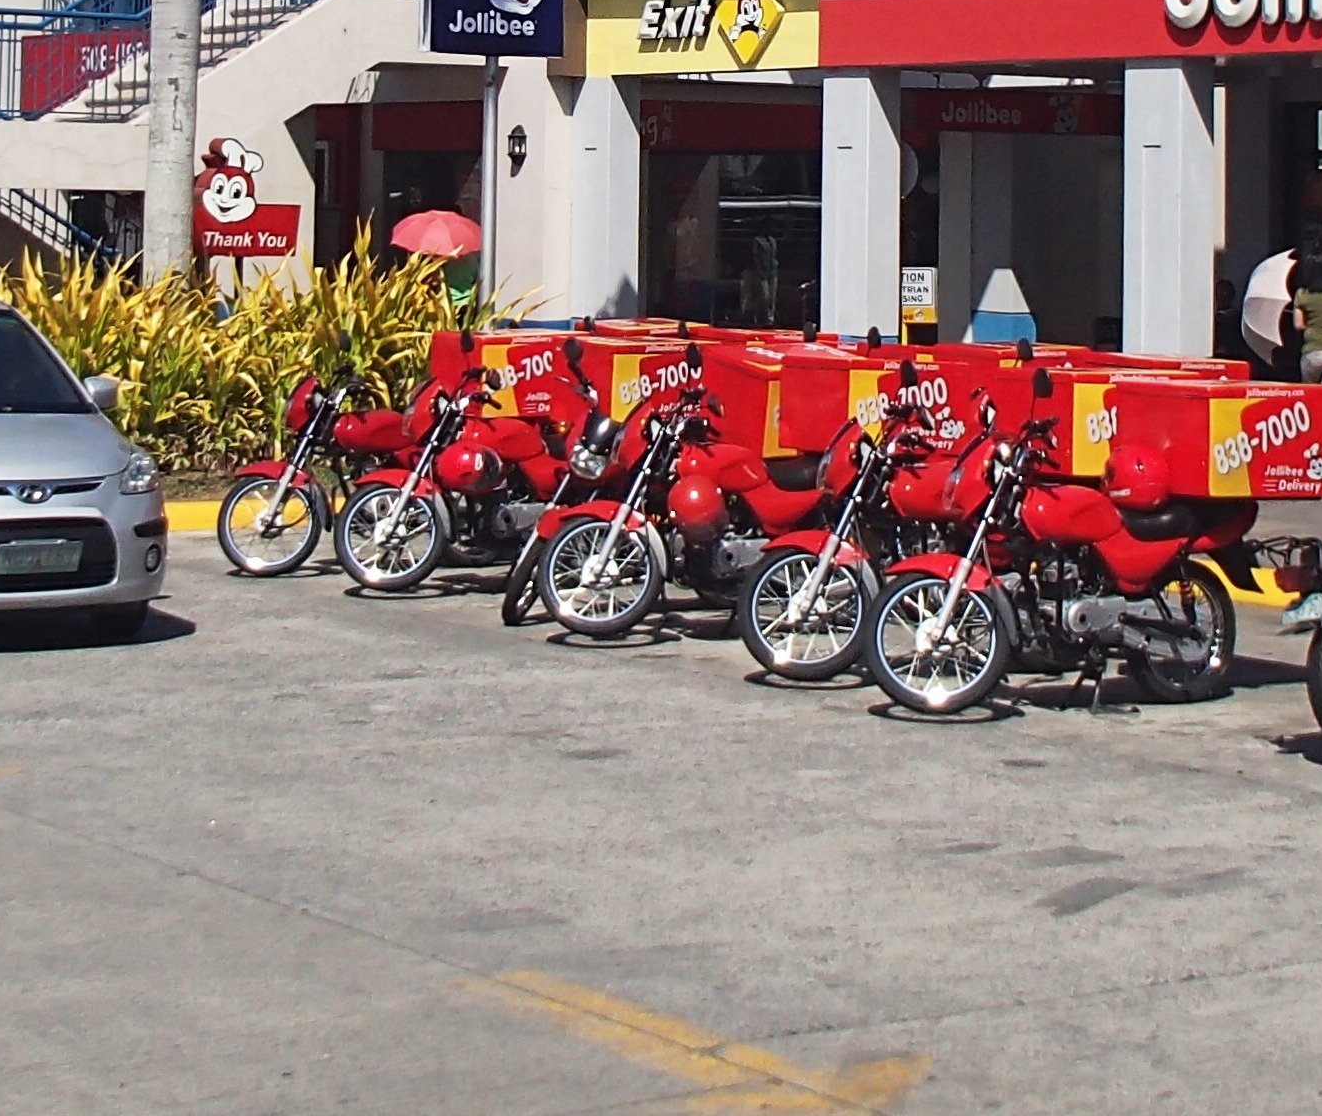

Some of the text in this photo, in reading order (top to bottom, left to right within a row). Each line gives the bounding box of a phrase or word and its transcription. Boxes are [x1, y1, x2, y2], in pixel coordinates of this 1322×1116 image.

[448, 9, 537, 37] Jollibee
[941, 99, 1023, 125] Jollibee
[203, 230, 288, 248] Thank You
[1213, 401, 1311, 475] 838-7000
[1264, 464, 1305, 477] Jollibee
[1278, 479, 1322, 495] Delivery
